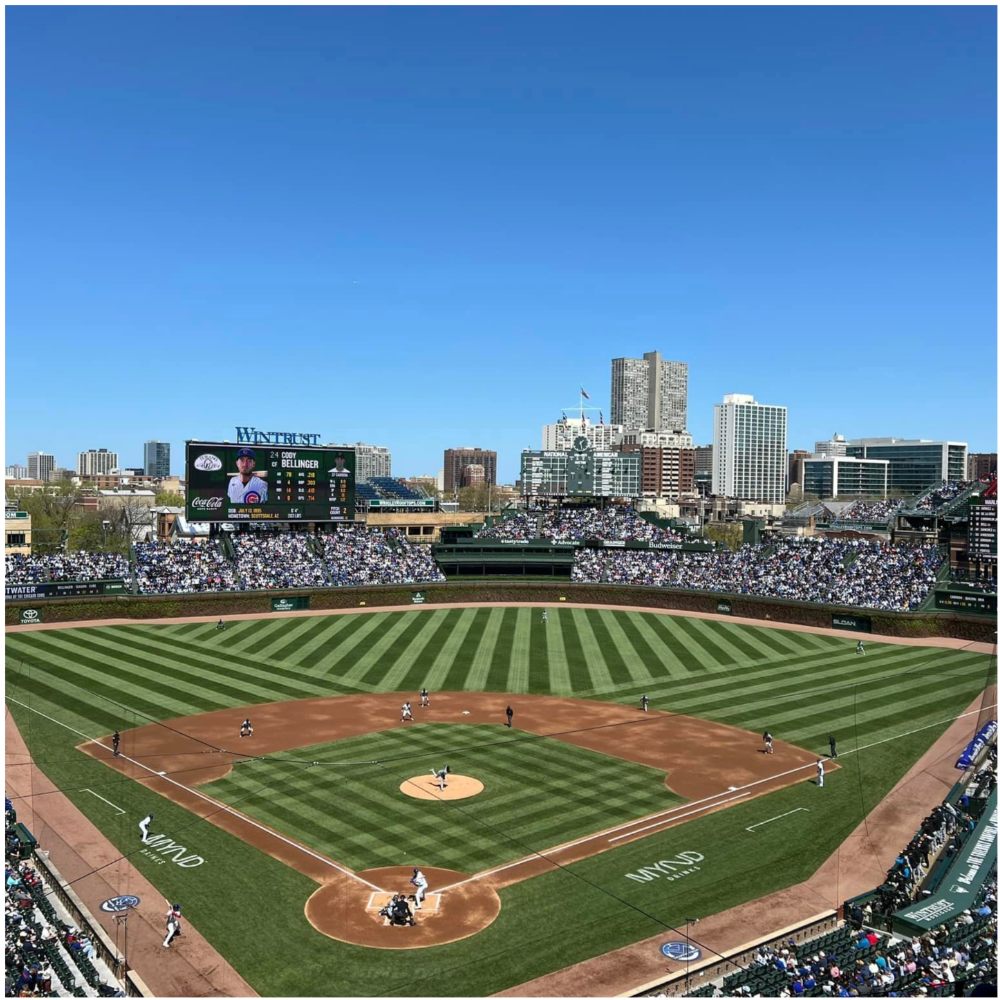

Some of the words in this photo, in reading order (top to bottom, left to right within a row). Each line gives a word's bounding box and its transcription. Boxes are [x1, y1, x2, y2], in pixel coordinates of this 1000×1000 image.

[236, 427, 321, 445] WINTRUST
[281, 451, 297, 459] CODY
[281, 459, 319, 469] BELLINGER
[191, 496, 224, 508] Coca-Cola
[648, 541, 683, 550] Budweiser
[624, 850, 705, 883] MYND
